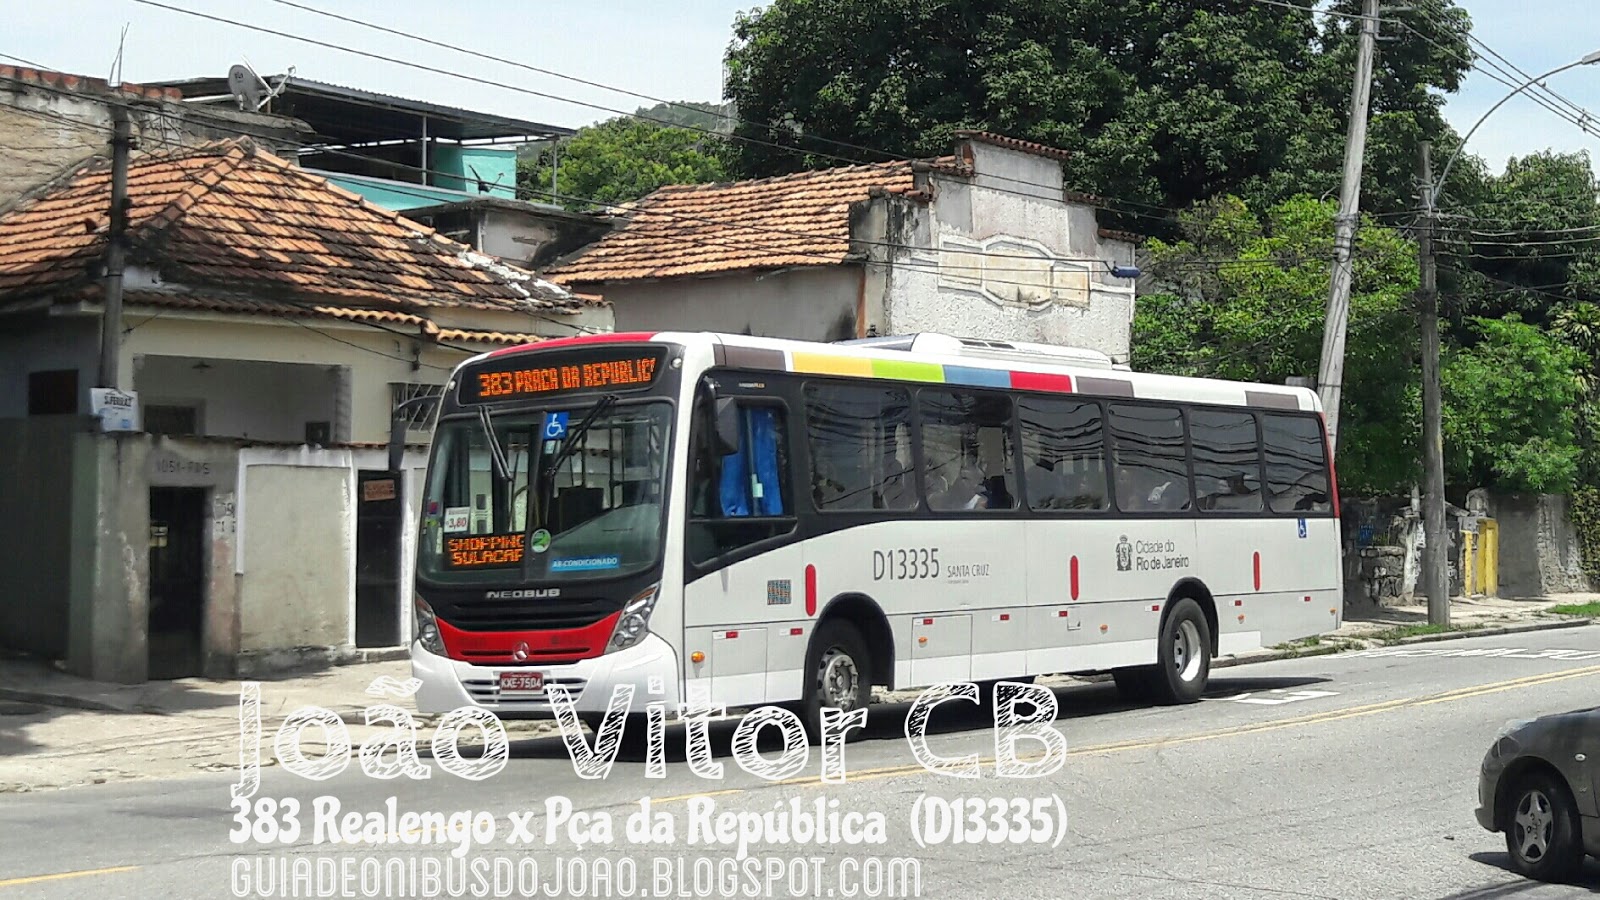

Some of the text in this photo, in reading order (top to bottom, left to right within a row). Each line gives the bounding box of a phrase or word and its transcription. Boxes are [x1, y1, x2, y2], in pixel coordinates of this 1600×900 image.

[479, 372, 513, 397] 383
[561, 366, 580, 389] DA
[1135, 539, 1175, 554] Cidade do
[873, 547, 940, 581] D13335
[947, 563, 990, 578] SANTA CRUZ
[1136, 554, 1190, 571] Rio de Janeiro
[486, 588, 561, 599] NEOBUS
